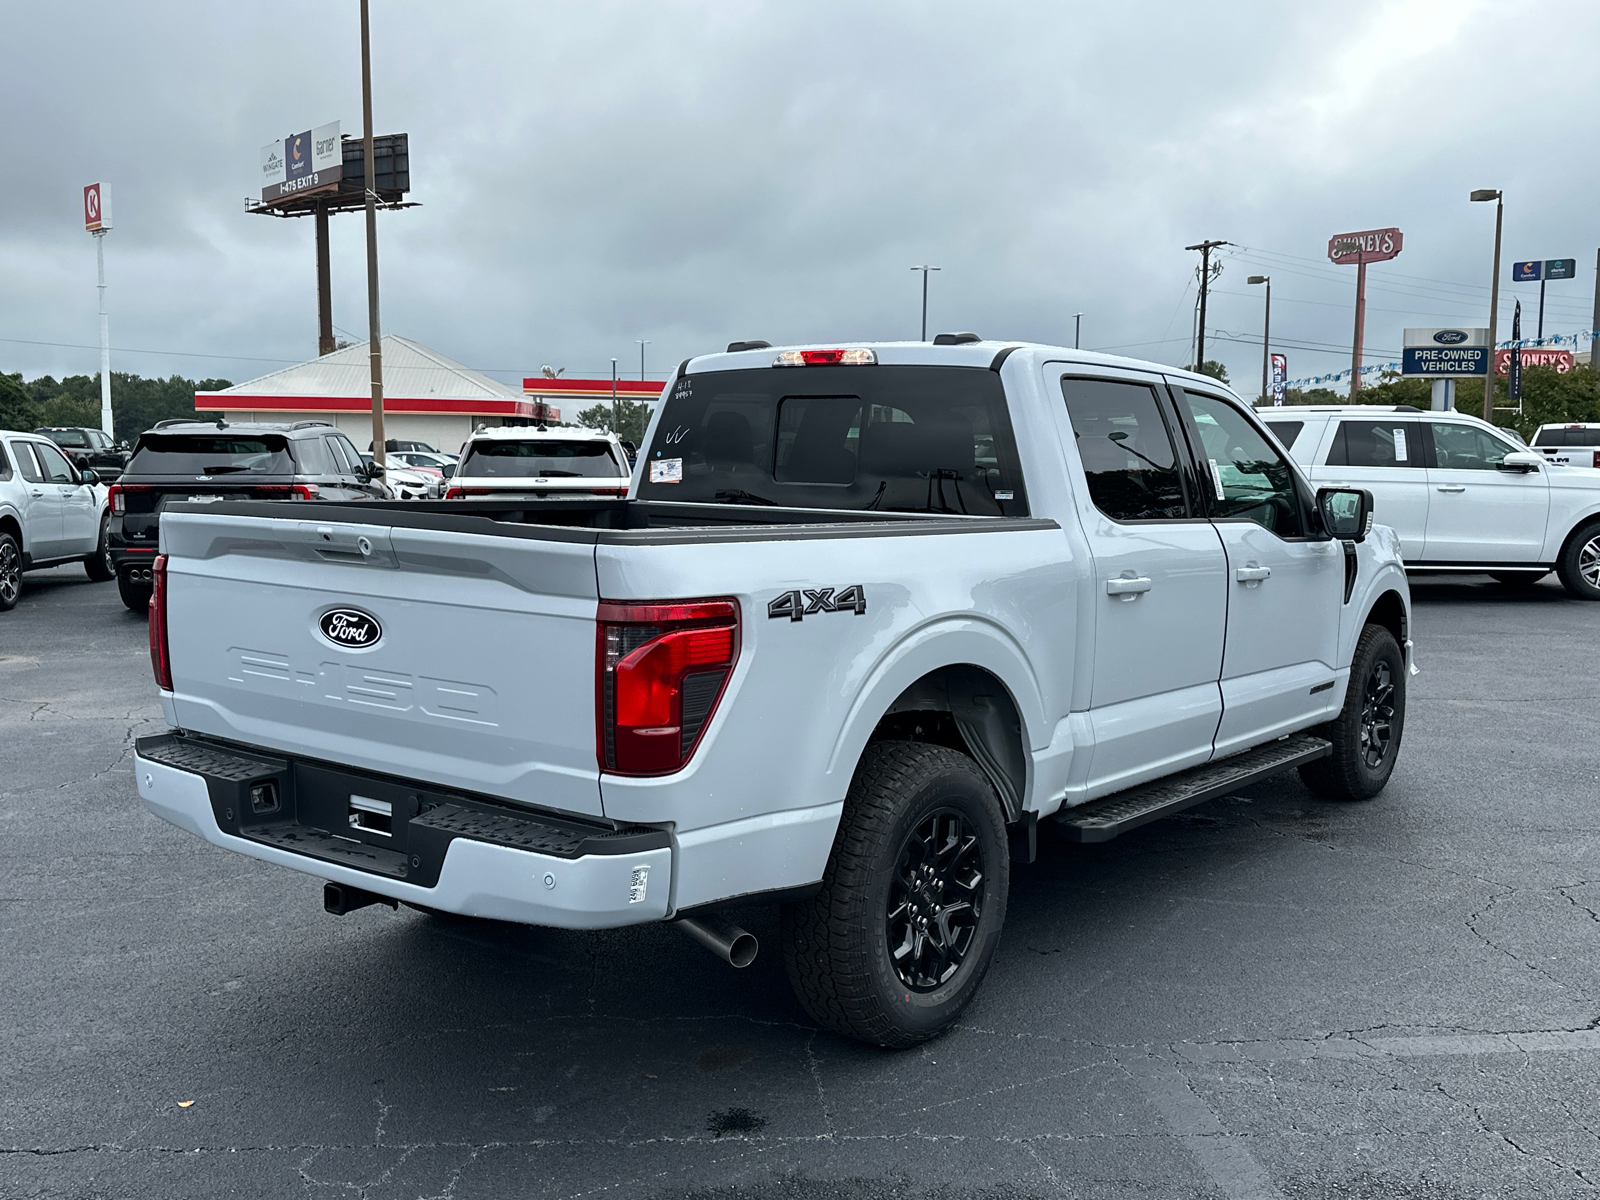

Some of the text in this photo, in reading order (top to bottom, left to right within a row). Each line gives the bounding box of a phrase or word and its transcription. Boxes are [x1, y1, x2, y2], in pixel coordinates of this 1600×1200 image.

[316, 137, 335, 155] Garner
[262, 159, 283, 173] WINGATE
[280, 173, 319, 194] I-475 EXIT 9
[1441, 333, 1462, 341] Ford
[1414, 350, 1482, 360] PRE-OWNED
[1421, 361, 1476, 371] VEHICLES
[328, 613, 368, 642] Ford
[226, 646, 499, 727] F-150
